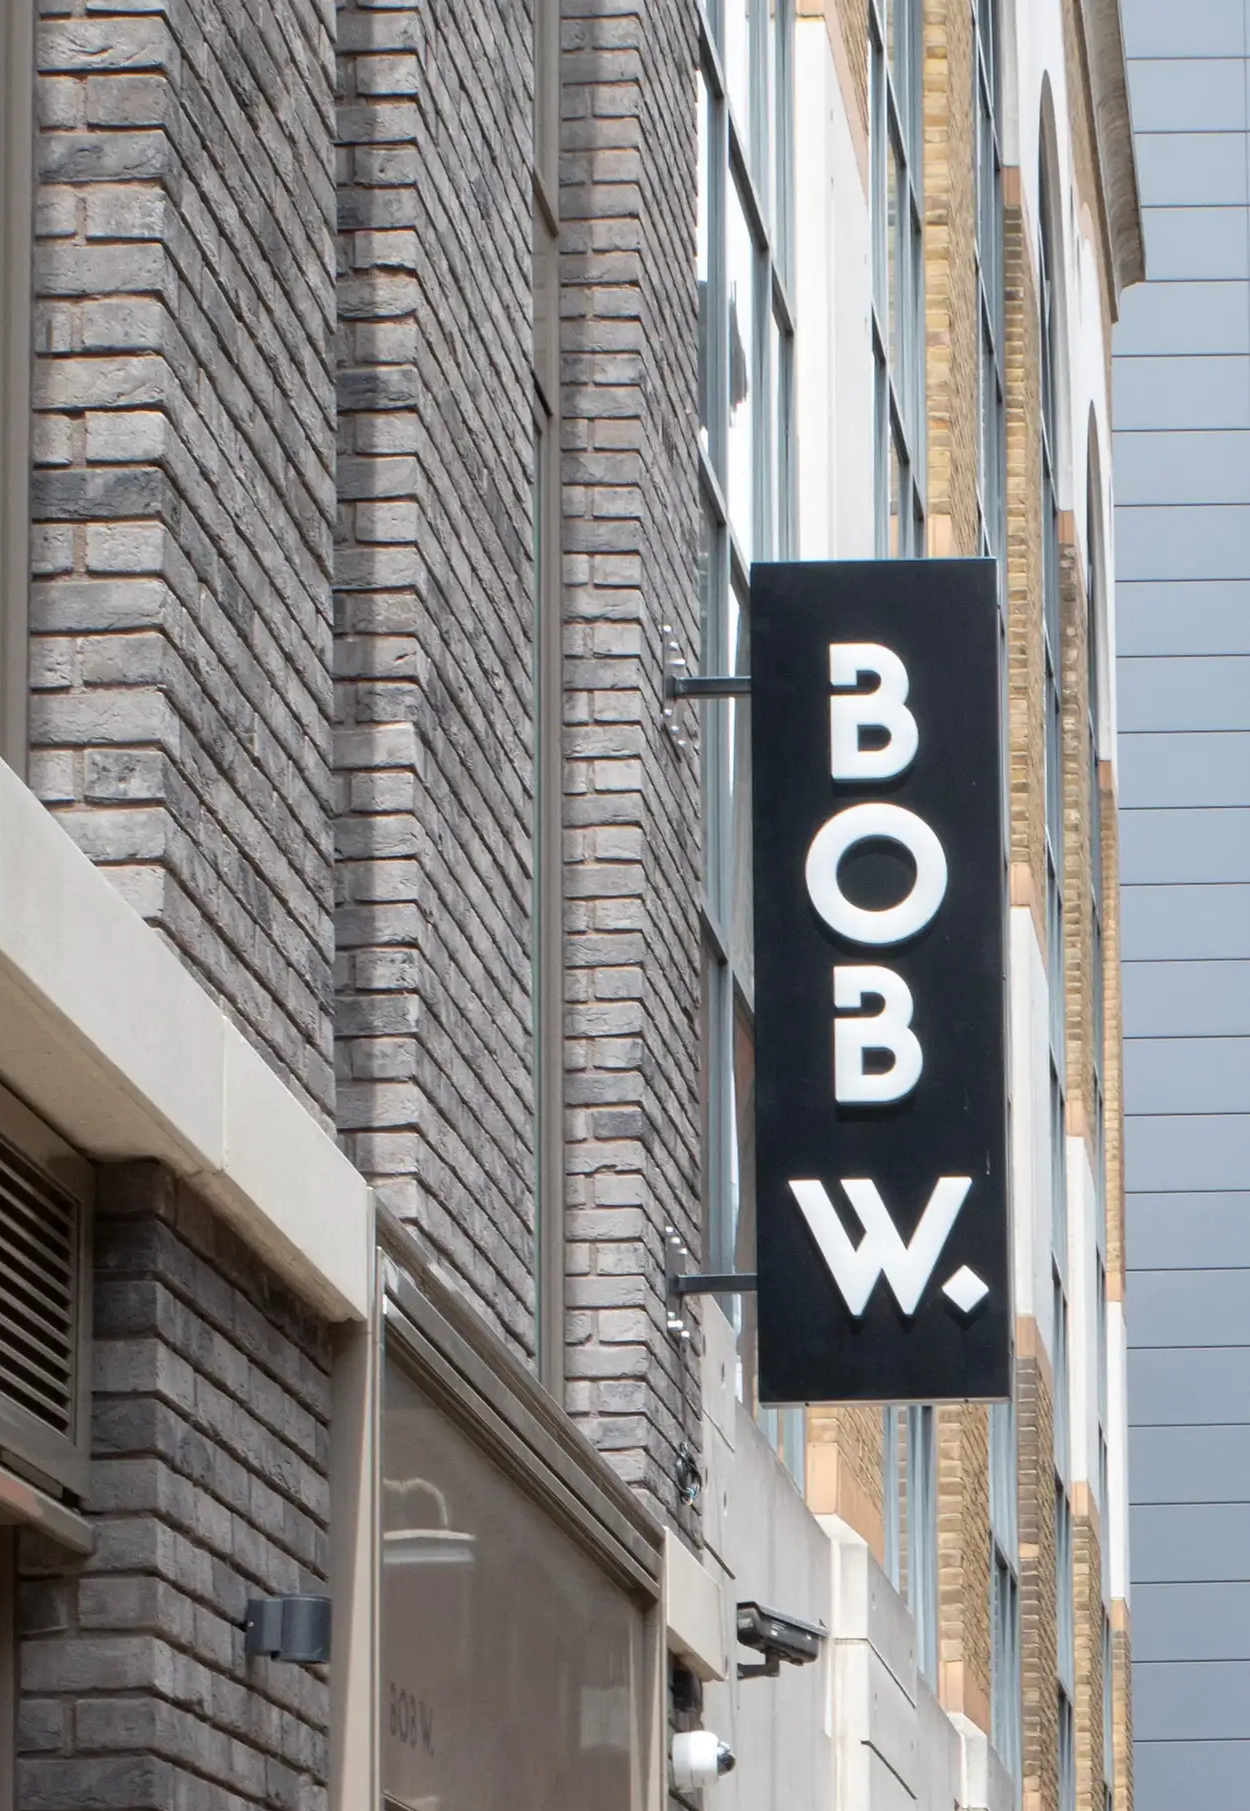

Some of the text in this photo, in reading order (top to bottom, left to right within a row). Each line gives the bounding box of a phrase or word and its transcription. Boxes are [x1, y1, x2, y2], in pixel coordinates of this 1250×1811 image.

[788, 642, 990, 1318] BOB W.
[389, 1680, 417, 1750] BOB
